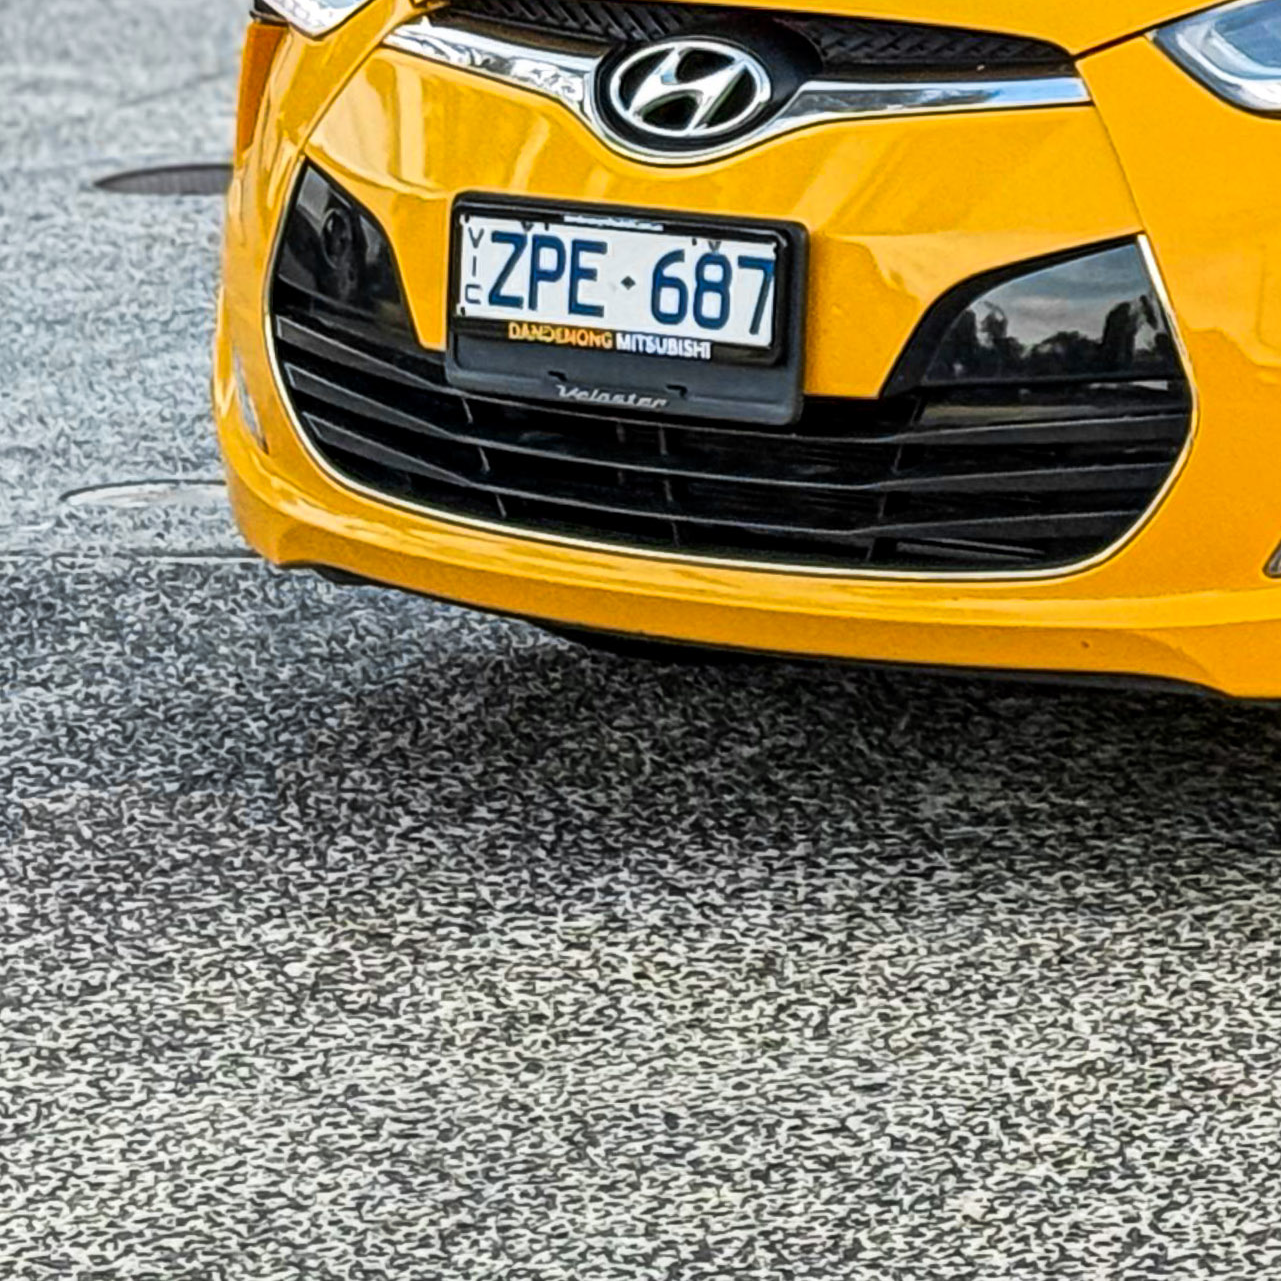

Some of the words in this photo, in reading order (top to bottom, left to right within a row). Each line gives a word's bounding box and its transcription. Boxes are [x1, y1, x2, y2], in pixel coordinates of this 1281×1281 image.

[465, 227, 485, 305] VIC
[488, 230, 608, 318] ZPE
[650, 248, 774, 335] 687
[508, 322, 613, 350] DANDENONG
[615, 332, 712, 360] MITSUBISHI
[556, 384, 668, 408] Veloster
